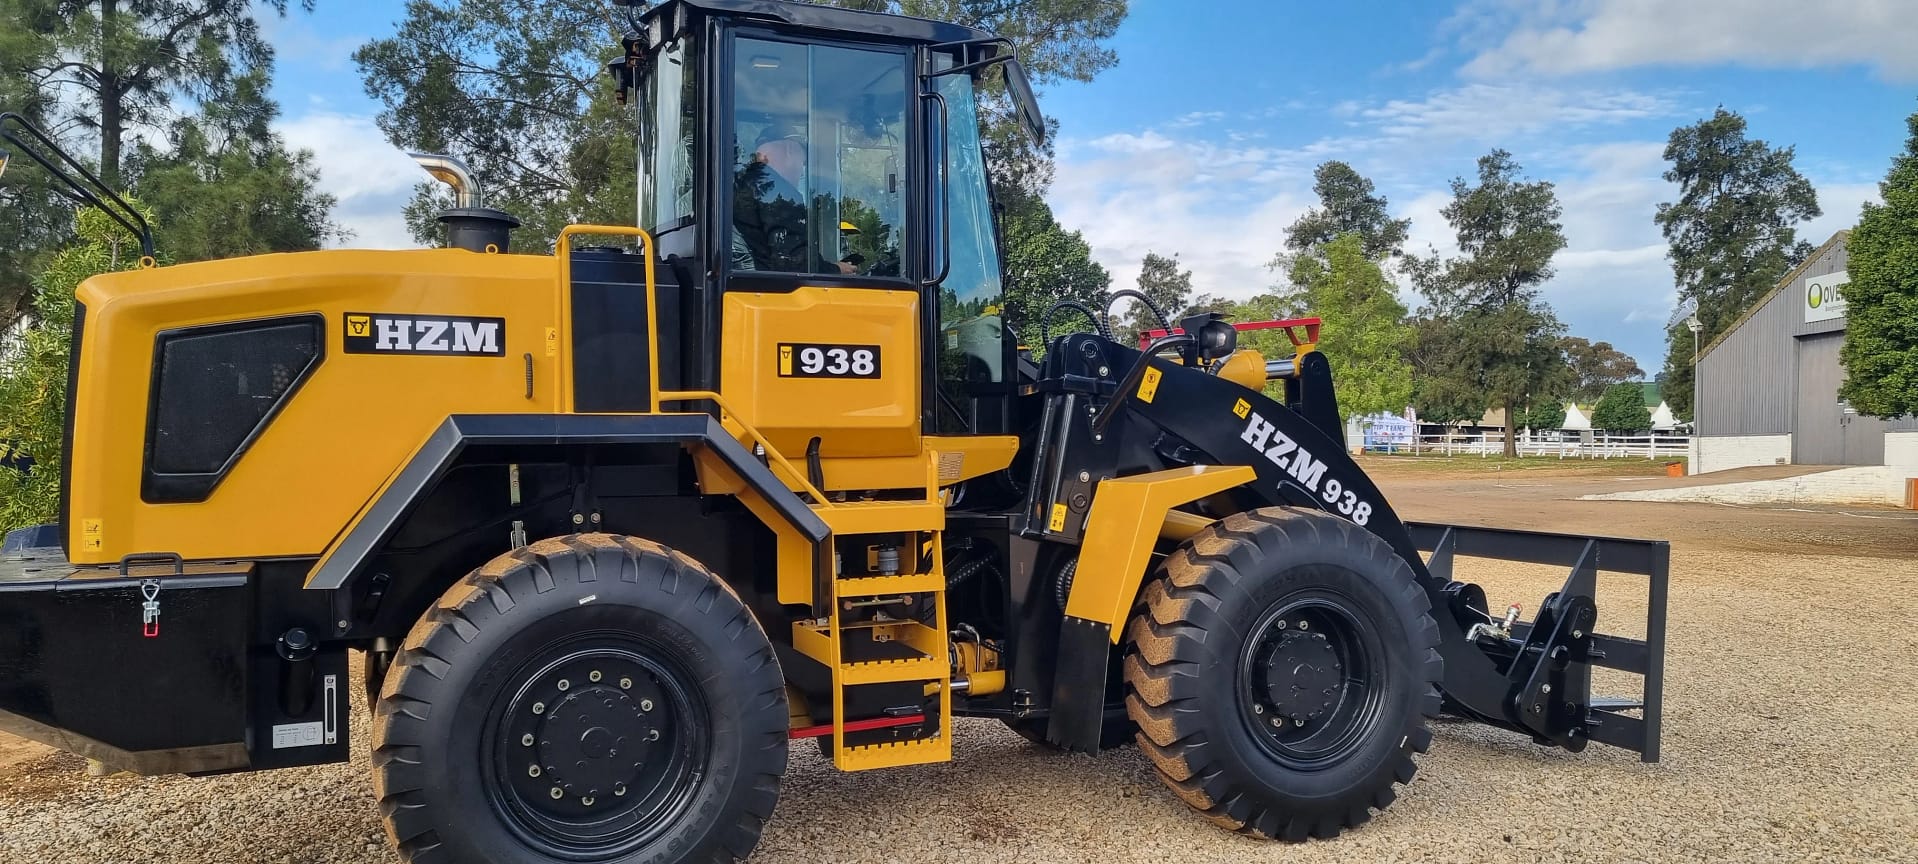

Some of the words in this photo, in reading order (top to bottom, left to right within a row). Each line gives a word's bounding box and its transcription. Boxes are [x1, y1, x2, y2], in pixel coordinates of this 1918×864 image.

[1823, 284, 1844, 303] OVE
[375, 319, 499, 353] HZM
[800, 347, 875, 375] 938
[1240, 411, 1328, 492] HZM
[1322, 479, 1372, 526] 938
